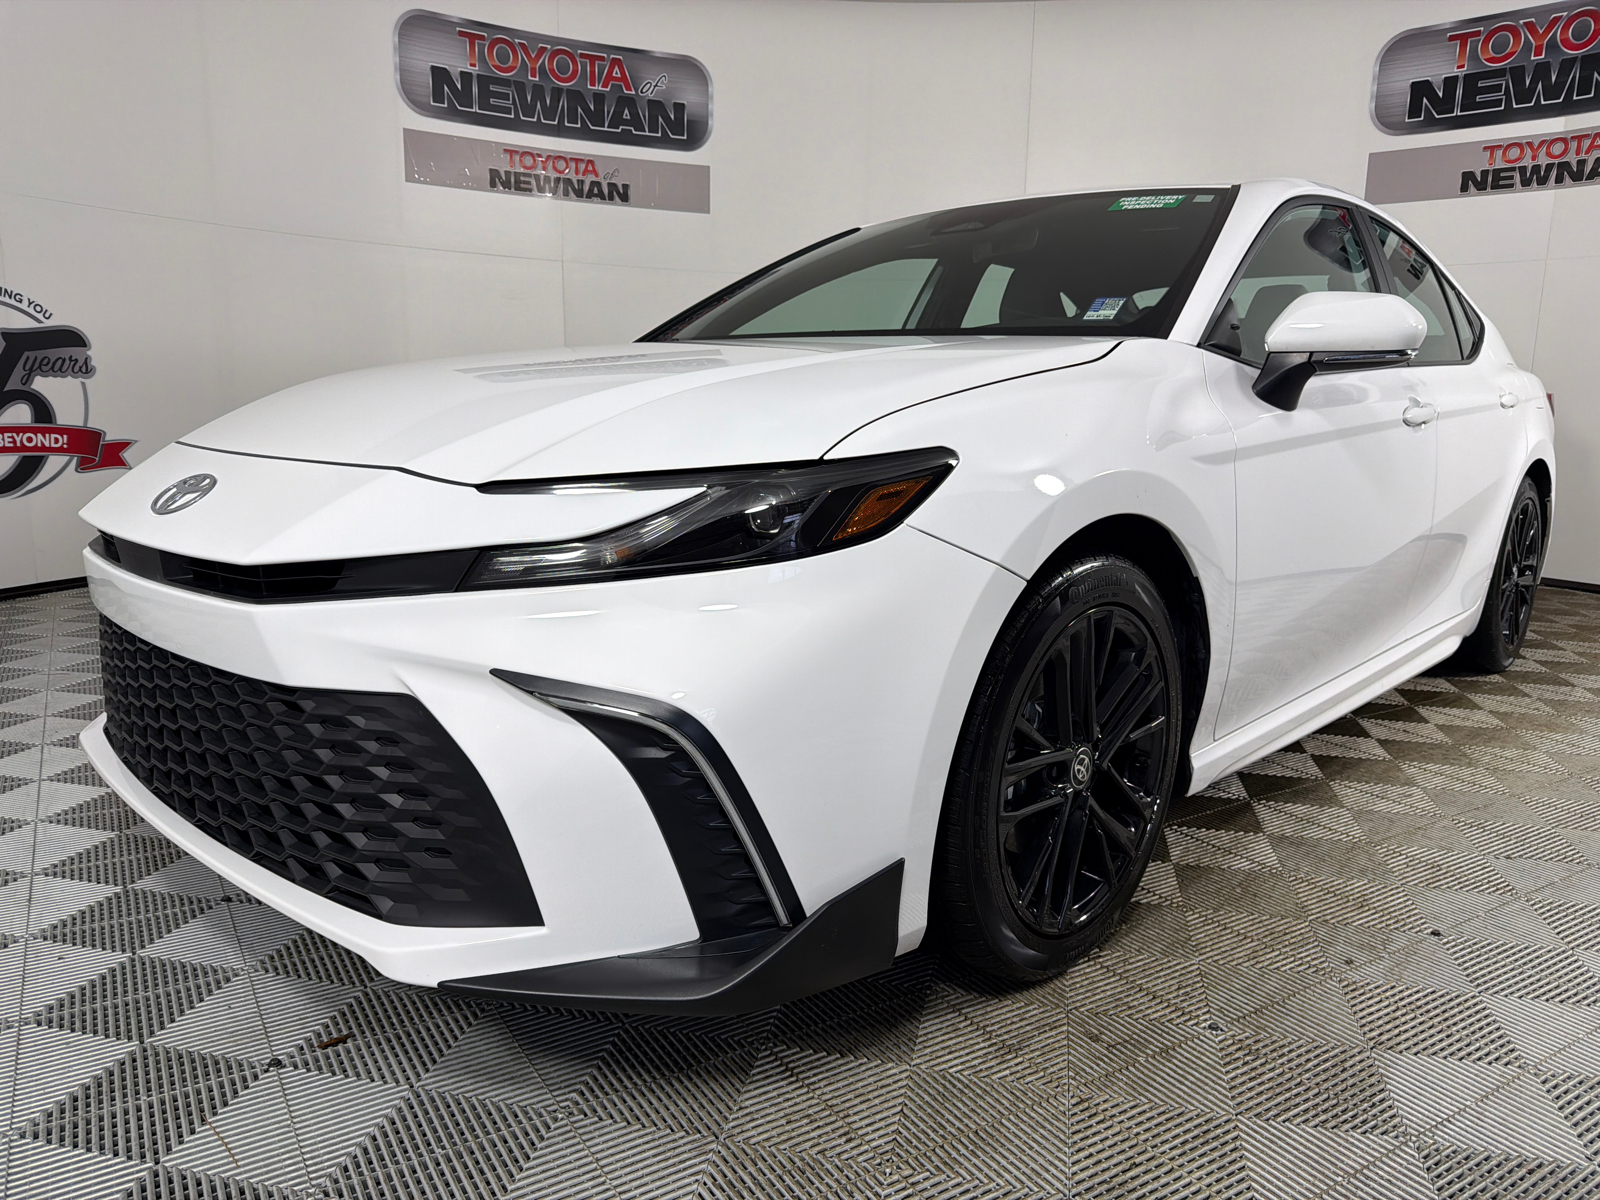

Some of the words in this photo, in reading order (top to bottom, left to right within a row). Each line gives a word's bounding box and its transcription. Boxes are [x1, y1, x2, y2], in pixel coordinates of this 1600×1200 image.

[1447, 6, 1600, 72] TOYO
[456, 28, 635, 94] TOYOTA
[638, 74, 667, 96] of
[430, 64, 688, 139] NEWNAN
[503, 148, 600, 179] TOYOTA
[603, 168, 619, 181] of
[488, 167, 631, 204] NEWNAN
[27, 297, 53, 320] YOU
[20, 354, 94, 386] years
